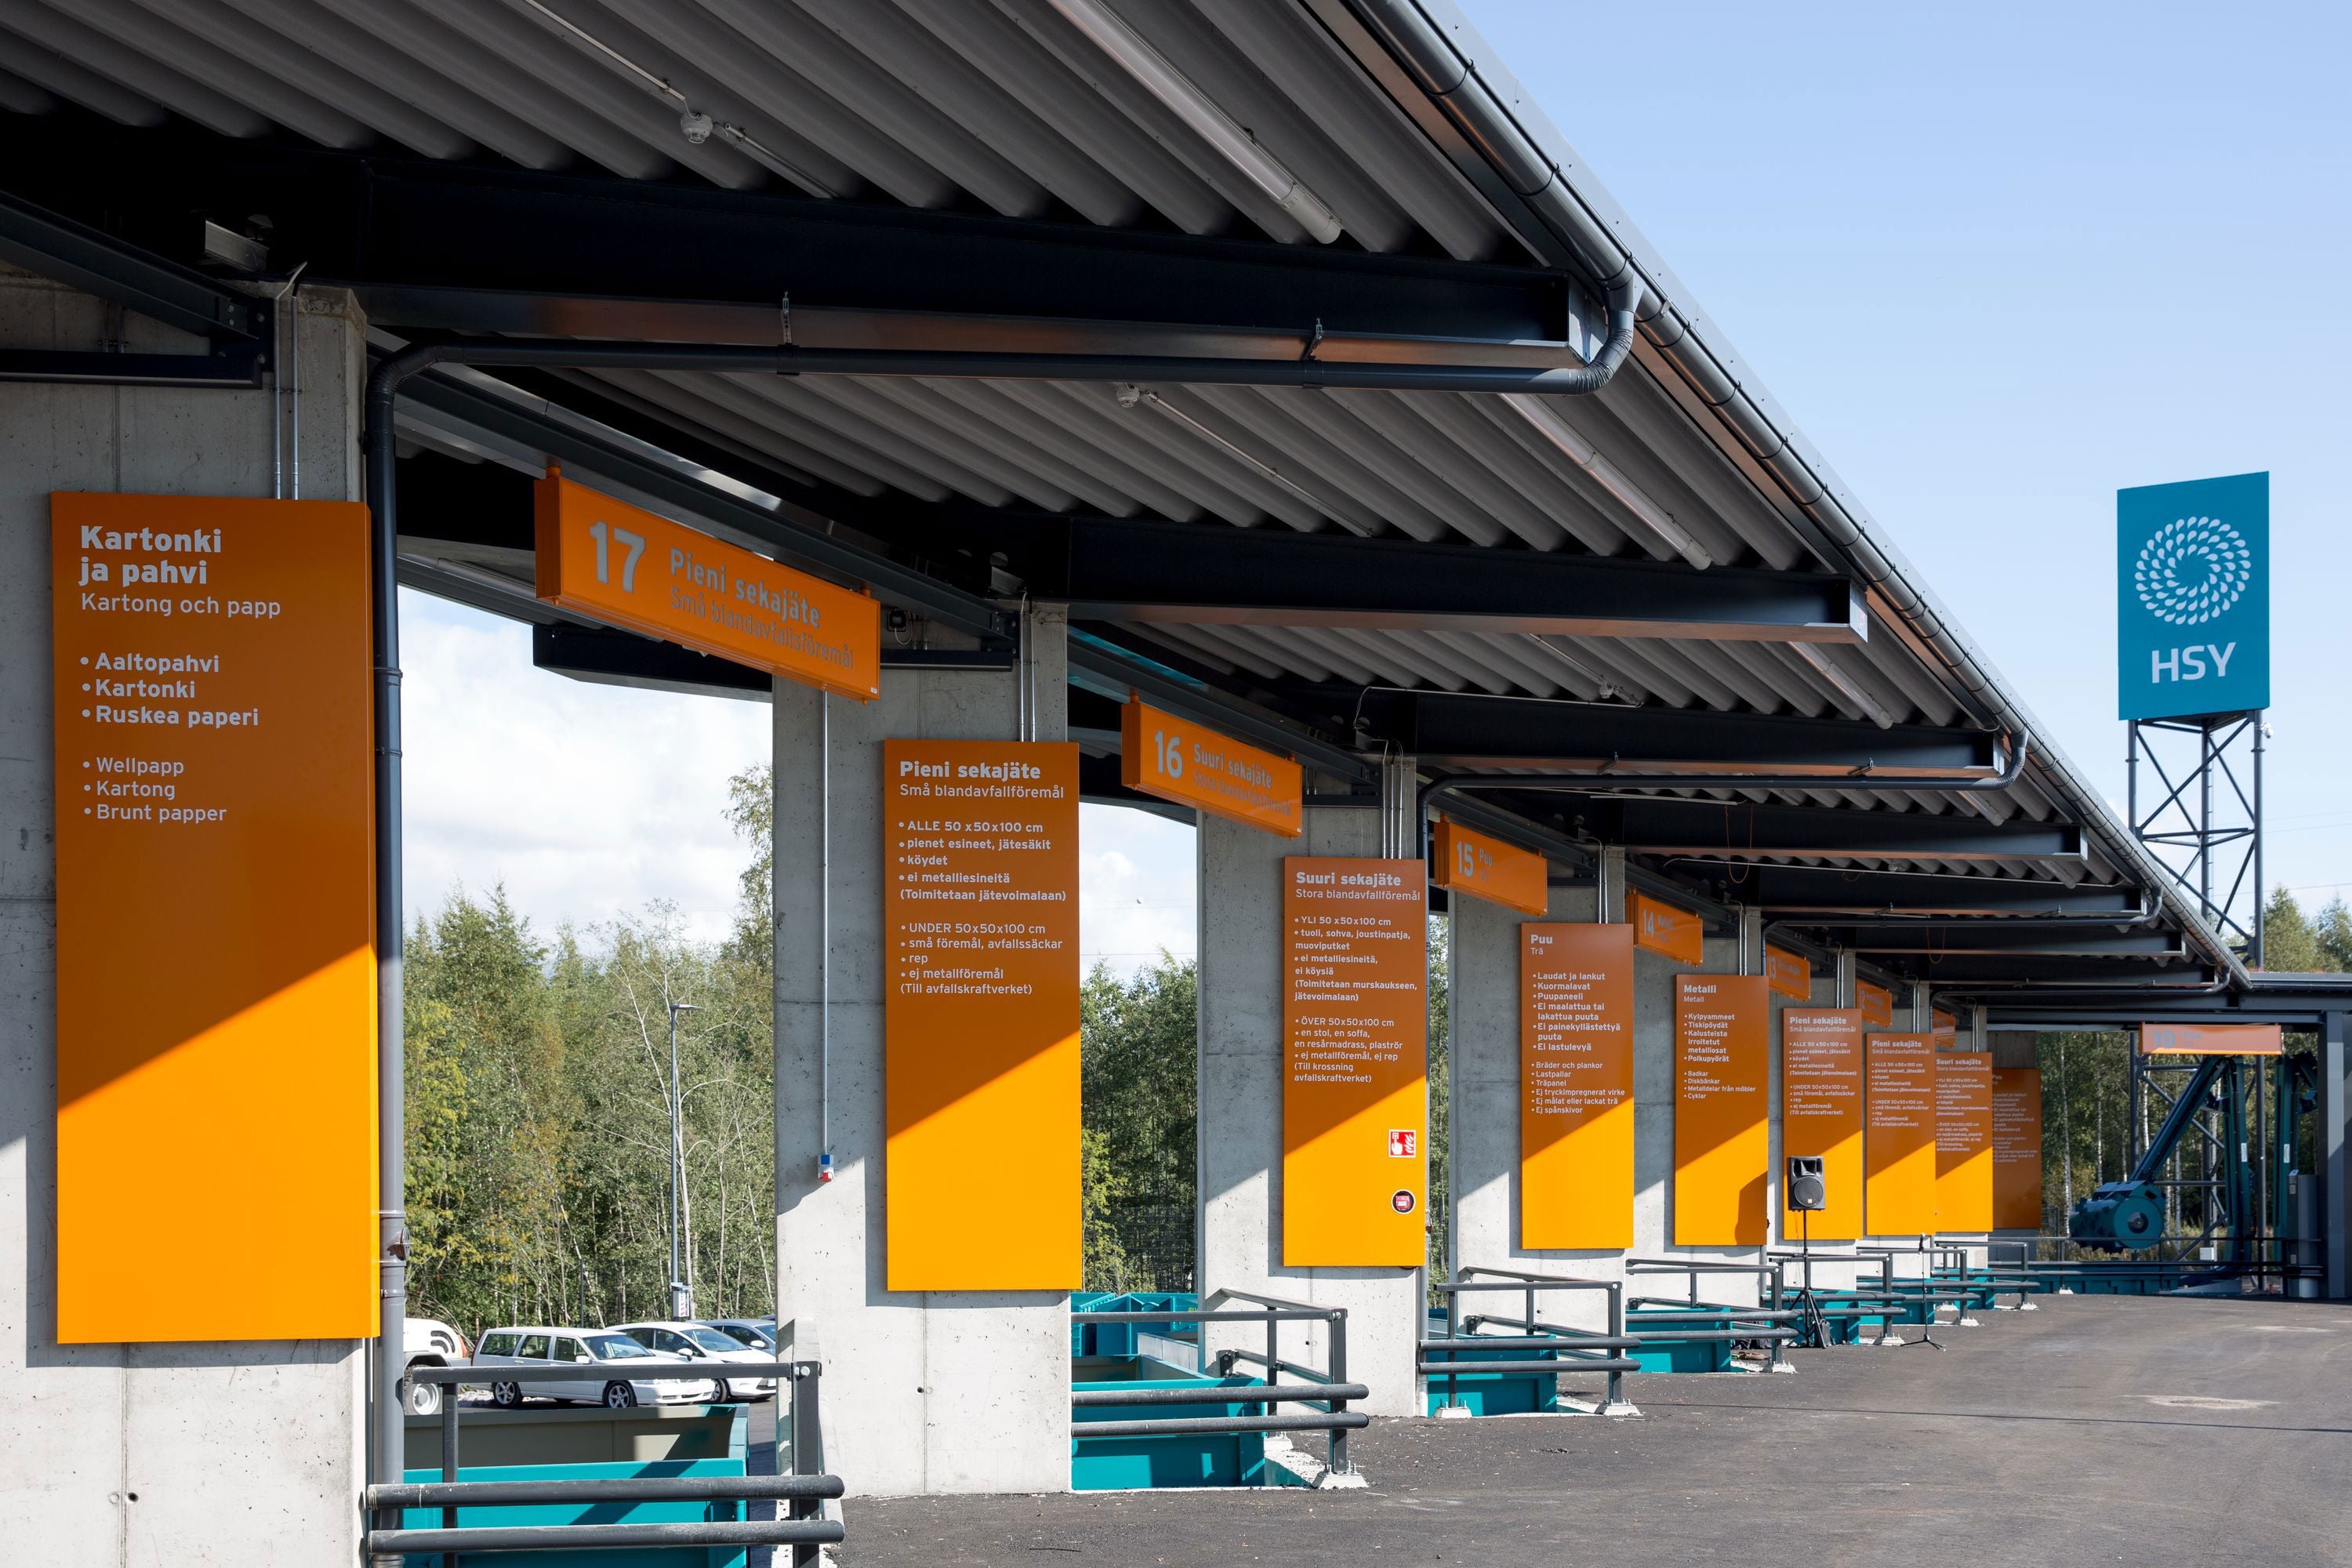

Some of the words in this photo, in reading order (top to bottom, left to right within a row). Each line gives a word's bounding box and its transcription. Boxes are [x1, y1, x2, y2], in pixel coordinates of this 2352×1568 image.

[80, 524, 222, 553] Kartonki
[589, 520, 646, 594] 17
[78, 557, 109, 586] ja
[122, 560, 208, 587] pahvi
[670, 547, 726, 593] Pieni
[735, 578, 820, 628] sekajäte
[82, 593, 172, 616] Kartong
[180, 596, 219, 614] och
[227, 599, 281, 619] papp
[670, 586, 706, 619] Små
[711, 601, 854, 670] blandavfallsföremål
[95, 652, 220, 675] Aaltopahvi
[2152, 642, 2236, 684] HSY
[96, 678, 195, 699] Kartonki
[96, 705, 179, 724] Ruskea
[188, 708, 259, 728] paperi
[1154, 730, 1183, 779] 16
[96, 757, 184, 777] Wellpapp
[900, 760, 949, 778] Pieni
[957, 762, 1040, 782] sekajäte
[1193, 743, 1224, 771] Suuri
[1228, 760, 1272, 788] sekajäte
[96, 780, 175, 800] Kartong
[899, 782, 931, 797] Små
[935, 784, 1064, 799] blandavfallföremål
[97, 804, 151, 820] Brunt
[159, 807, 227, 823] papper
[907, 821, 941, 831] ALLE
[945, 821, 961, 831] 50
[1025, 824, 1044, 833] cm
[907, 837, 945, 849] pienet
[948, 839, 995, 850] esineet,
[998, 839, 1051, 851] jätesäkit
[907, 855, 948, 867] köydet
[1457, 840, 1474, 877] 15
[1479, 847, 1494, 866] Puu
[907, 873, 918, 882] ei
[921, 873, 1010, 883] metalliesineitä
[1296, 871, 1335, 884] Suuri
[1341, 873, 1402, 888] sekajäte
[900, 888, 975, 900] (Toimitetaan
[978, 891, 1066, 902] jätevoimalaan)
[1296, 888, 1323, 898] Stora
[1327, 890, 1421, 901] blandavfallföremål
[909, 923, 951, 933] UNDER
[955, 923, 1025, 934] 50x50x100
[1028, 924, 1045, 934] cm
[1643, 909, 1654, 939] 14
[1301, 929, 1323, 938] tuoli,
[1326, 930, 1354, 938] sohva,
[1356, 930, 1410, 940] joustinpatja,
[1530, 934, 1553, 945] Puu
[909, 937, 933, 949] små
[936, 938, 984, 950] föremål,
[987, 939, 1063, 949] avfallssäckar
[1295, 942, 1350, 951] muoviputket
[909, 954, 928, 964] rep
[1311, 955, 1378, 964] metalliesineitä,
[909, 969, 920, 980] ej
[923, 967, 1004, 979] metallföremål
[1305, 967, 1334, 976] köysiä
[1569, 972, 1577, 982] ja
[900, 983, 922, 995] (Till
[925, 984, 1033, 996] avfallskraftverket)
[1295, 979, 1350, 989] (Toimitetaan
[1352, 981, 1417, 990] murskaukseen,
[1683, 985, 1716, 993] Metalli
[1294, 992, 1359, 1001] jätevoimalaan)
[1537, 993, 1584, 1001] Puupaneeli
[1537, 1002, 1546, 1011] Ei
[1301, 1015, 1326, 1025] ÖVER
[1329, 1018, 1379, 1026] 50x50x100
[1575, 1013, 1599, 1022] puuta
[1813, 1017, 1847, 1025] sekajäte
[1314, 1029, 1332, 1037] stol,
[1347, 1029, 1370, 1038] soffa,
[1548, 1023, 1621, 1033] painekyllästettyä
[1537, 1033, 1563, 1042] puuta
[2153, 1029, 2176, 1047] 10
[1307, 1039, 1367, 1049] resårmadrass,
[1369, 1041, 1403, 1050] plaströr
[1548, 1043, 1592, 1052] lastulevyä
[1301, 1051, 1308, 1060] ej
[1311, 1051, 1372, 1061] metallföremål,
[1374, 1053, 1381, 1062] ej
[1688, 1054, 1730, 1063] Polkupyörät
[1294, 1062, 1310, 1071] (Till
[1312, 1063, 1354, 1072] krossning
[1294, 1073, 1372, 1083] avfallskraftverket)
[1544, 1088, 1606, 1097] tryckimpregnerat
[1544, 1096, 1565, 1105] målat
[1544, 1105, 1583, 1114] spånskivor
